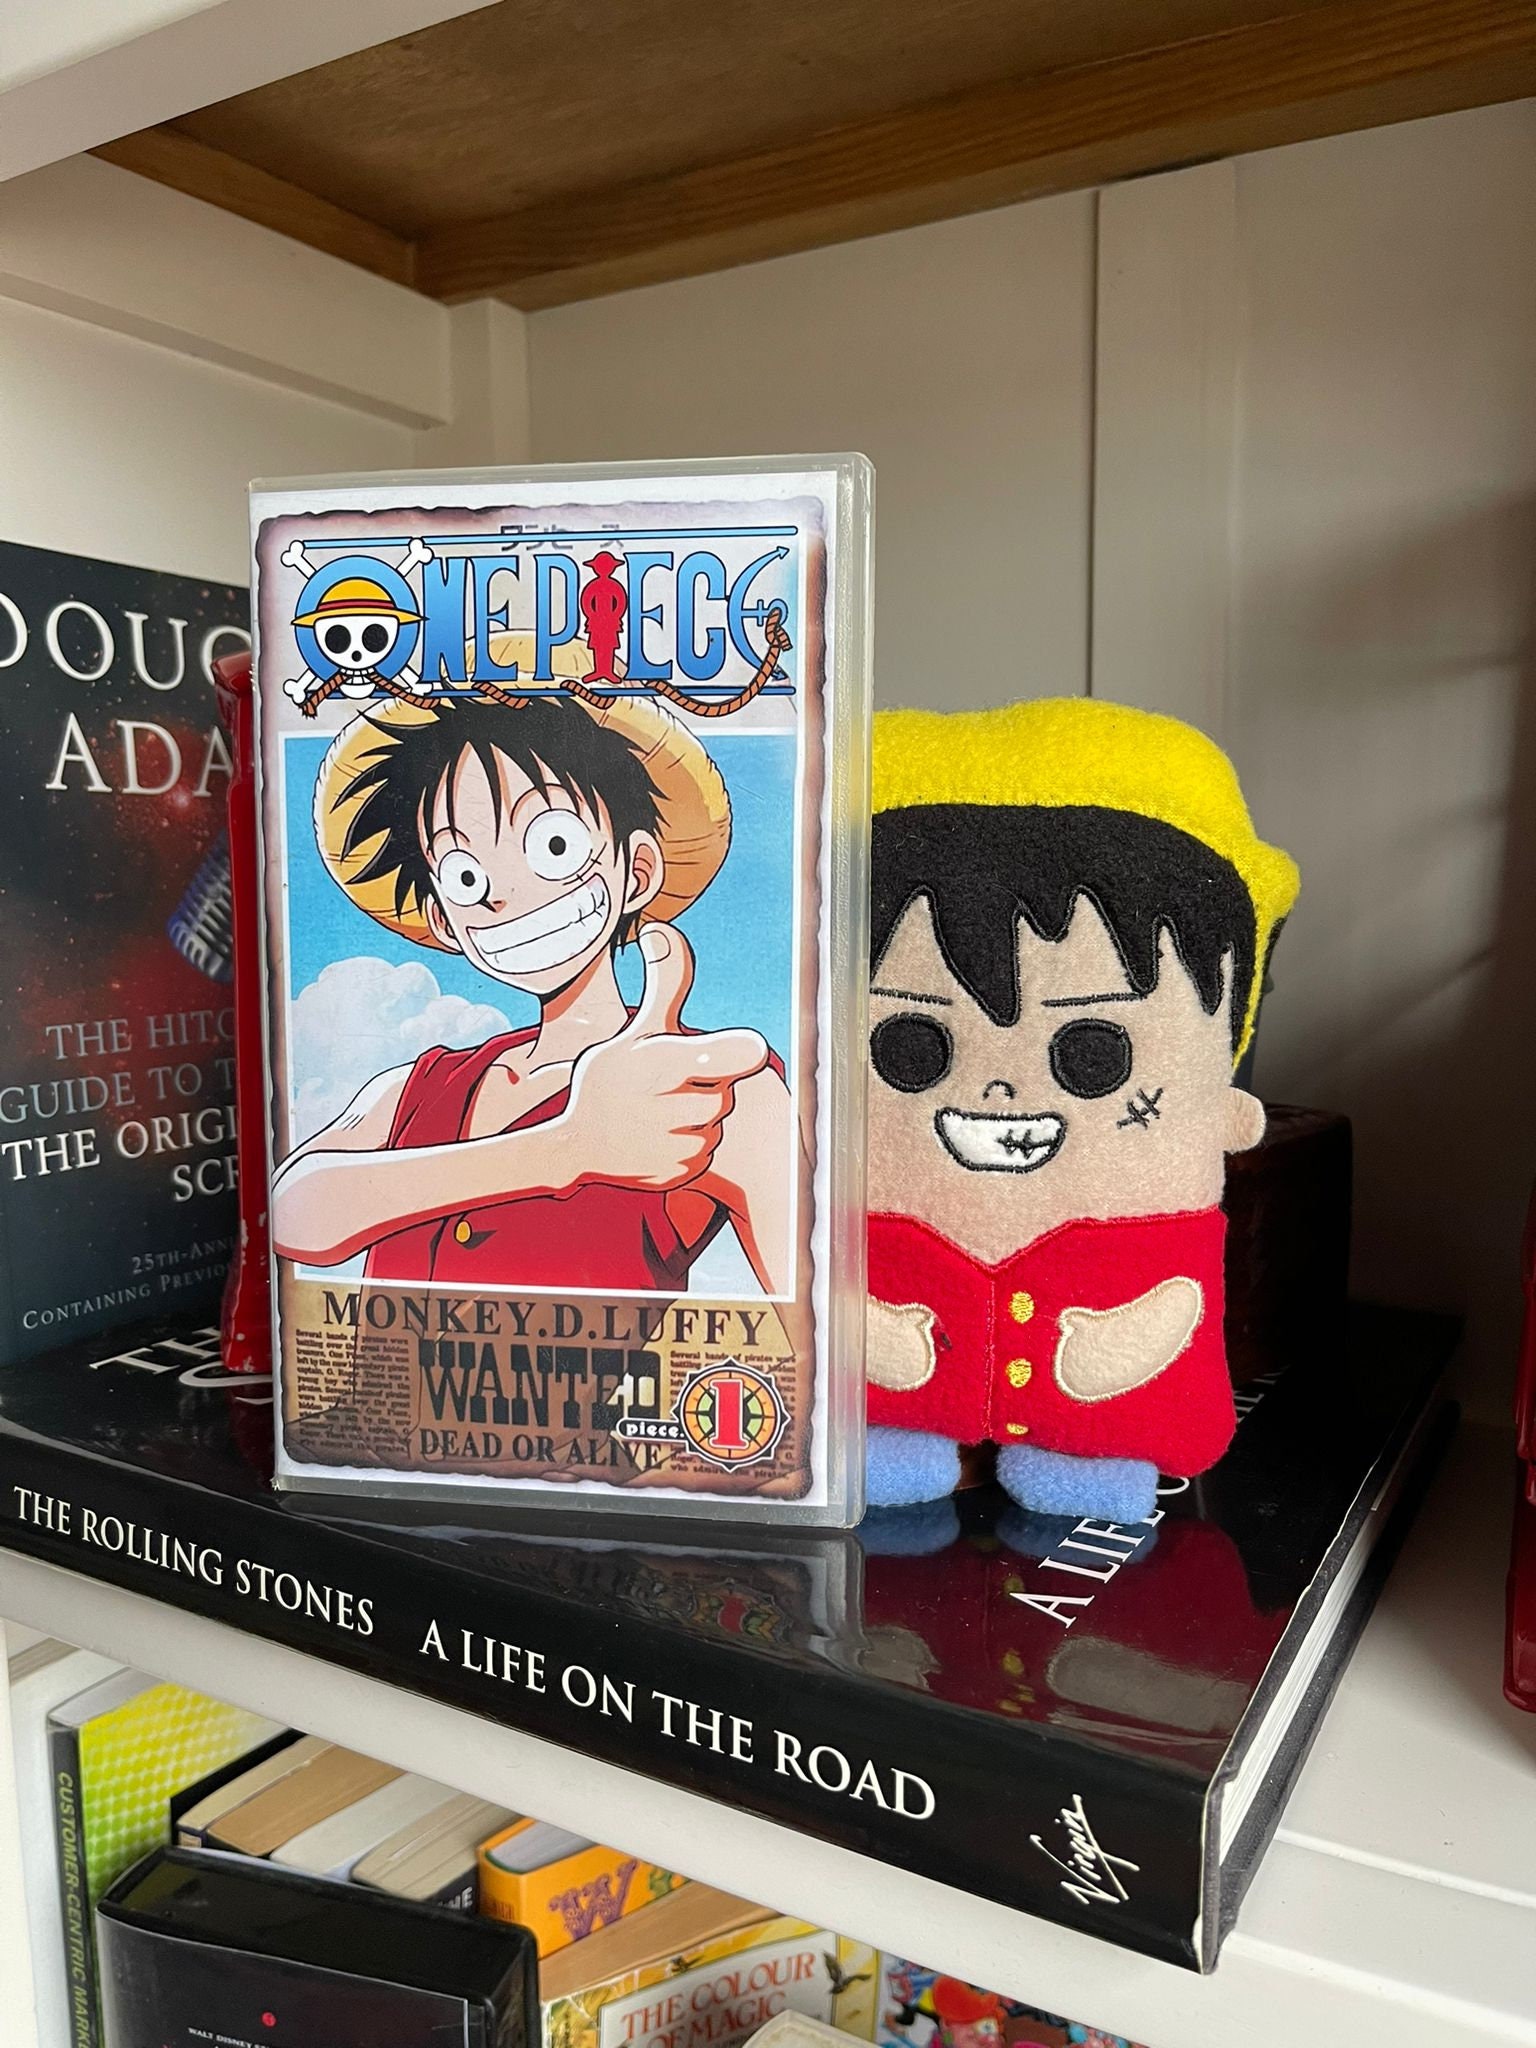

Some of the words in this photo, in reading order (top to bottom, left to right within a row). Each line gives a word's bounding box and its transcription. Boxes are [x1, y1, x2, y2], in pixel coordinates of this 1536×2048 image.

[295, 553, 521, 685] ONE
[535, 546, 790, 684] PIECE
[46, 1019, 132, 1060] THE
[0, 1072, 135, 1124] GUIDE
[148, 1063, 200, 1100] TO
[2, 1128, 100, 1181] THE
[322, 1290, 768, 1346] MONKEY.D.LUFFY
[708, 1379, 748, 1449] 1
[419, 1429, 501, 1459] DEAD
[512, 1434, 555, 1463] OR
[567, 1435, 663, 1472] ALIVE
[1037, 1507, 1166, 1584] LIF
[1009, 1592, 1095, 1629] A
[14, 1486, 71, 1535] THE
[82, 1508, 224, 1586] ROLLING
[236, 1558, 374, 1636] STONES
[419, 1620, 449, 1662] A
[461, 1629, 547, 1694] LIFE
[561, 1665, 636, 1724] ON
[652, 1690, 754, 1764] THE
[773, 1729, 936, 1820] ROAD
[59, 1771, 87, 1983] CUSTOMER-CENTRIC
[1030, 1793, 1140, 1905] Virgin
[621, 1993, 684, 2041] THE
[691, 1951, 816, 2013] COLOUR
[691, 1991, 786, 2045] MAGIC
